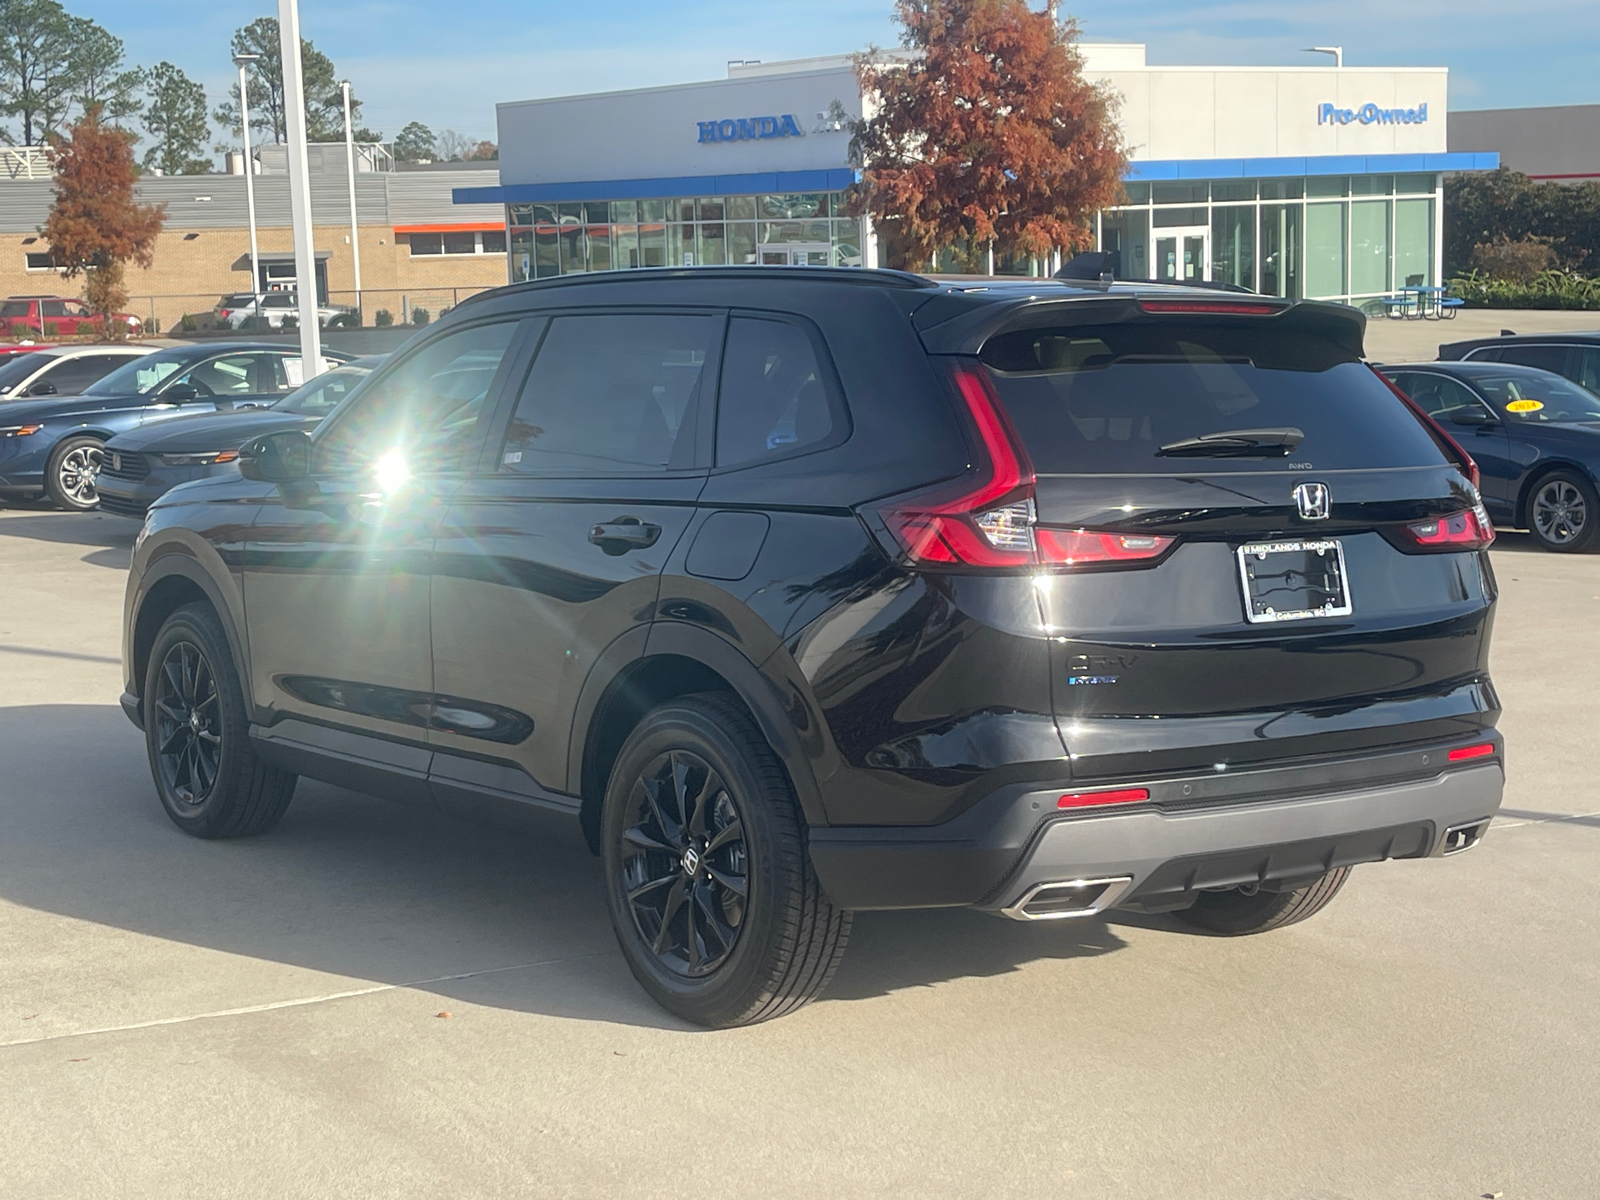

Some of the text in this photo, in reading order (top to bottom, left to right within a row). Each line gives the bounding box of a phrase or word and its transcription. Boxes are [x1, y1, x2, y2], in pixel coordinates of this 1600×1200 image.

[1318, 102, 1428, 125] Pre-Owned
[696, 114, 805, 144] HONDA
[1288, 462, 1313, 470] AWD
[1251, 540, 1336, 553] MIDLANDS HONDA
